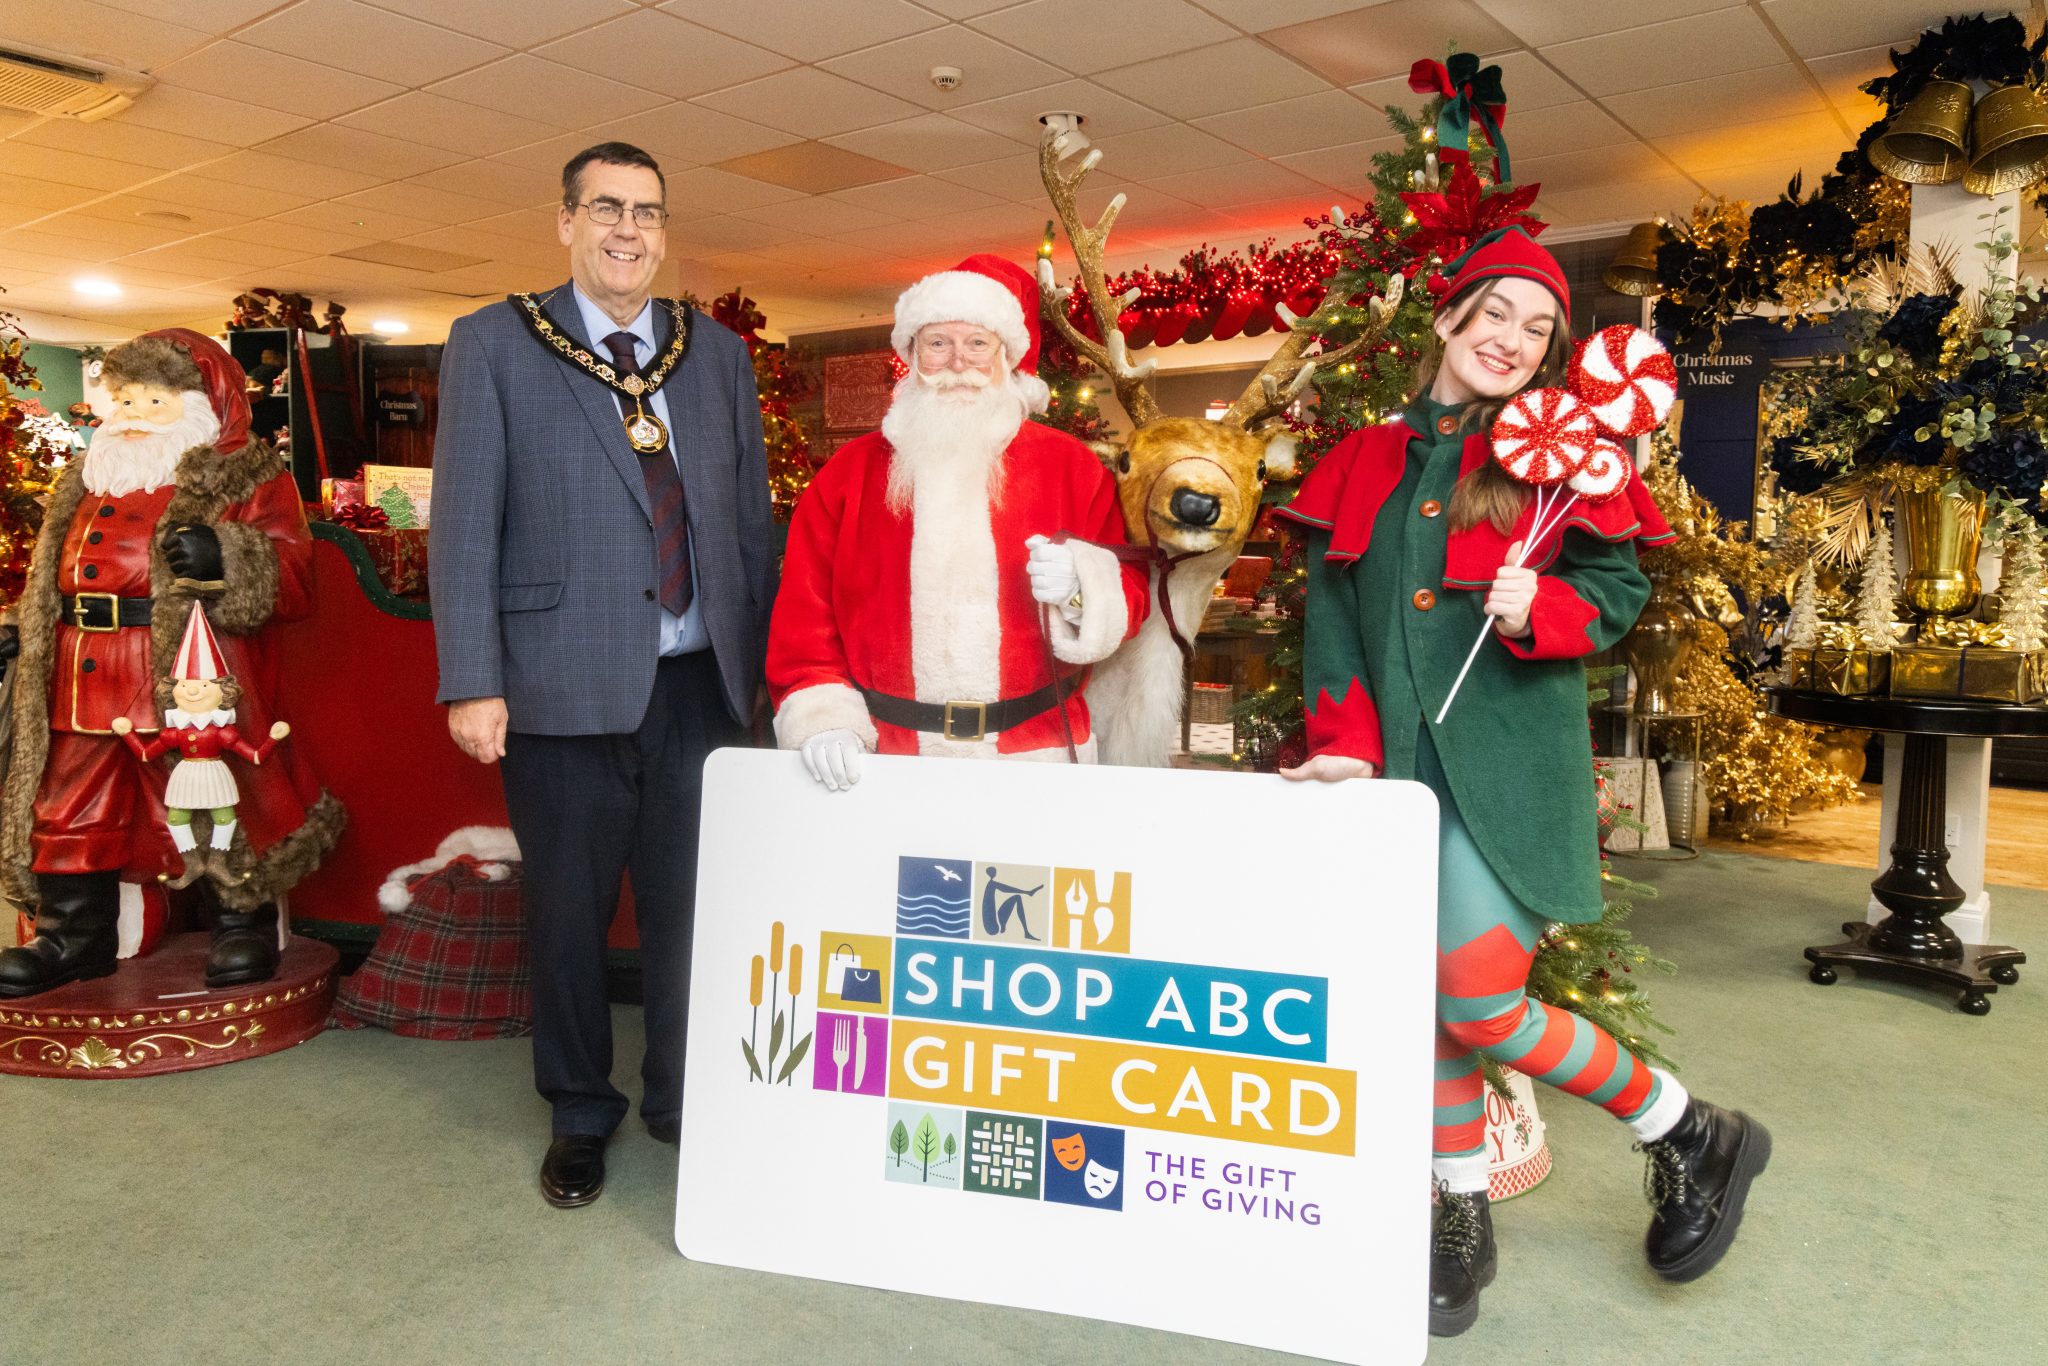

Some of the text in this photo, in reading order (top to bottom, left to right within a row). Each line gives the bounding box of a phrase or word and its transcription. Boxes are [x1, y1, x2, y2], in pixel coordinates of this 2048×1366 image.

[1673, 353, 1753, 367] Christmas
[1688, 371, 1735, 385] Music
[380, 400, 417, 409] Christmas
[390, 412, 408, 421] Barn
[906, 953, 1313, 1045] SHOP ABC
[904, 1036, 1341, 1137] GIFT CARD
[1146, 1151, 1297, 1191] THE GIFT
[1146, 1181, 1321, 1226] OF GIVING
